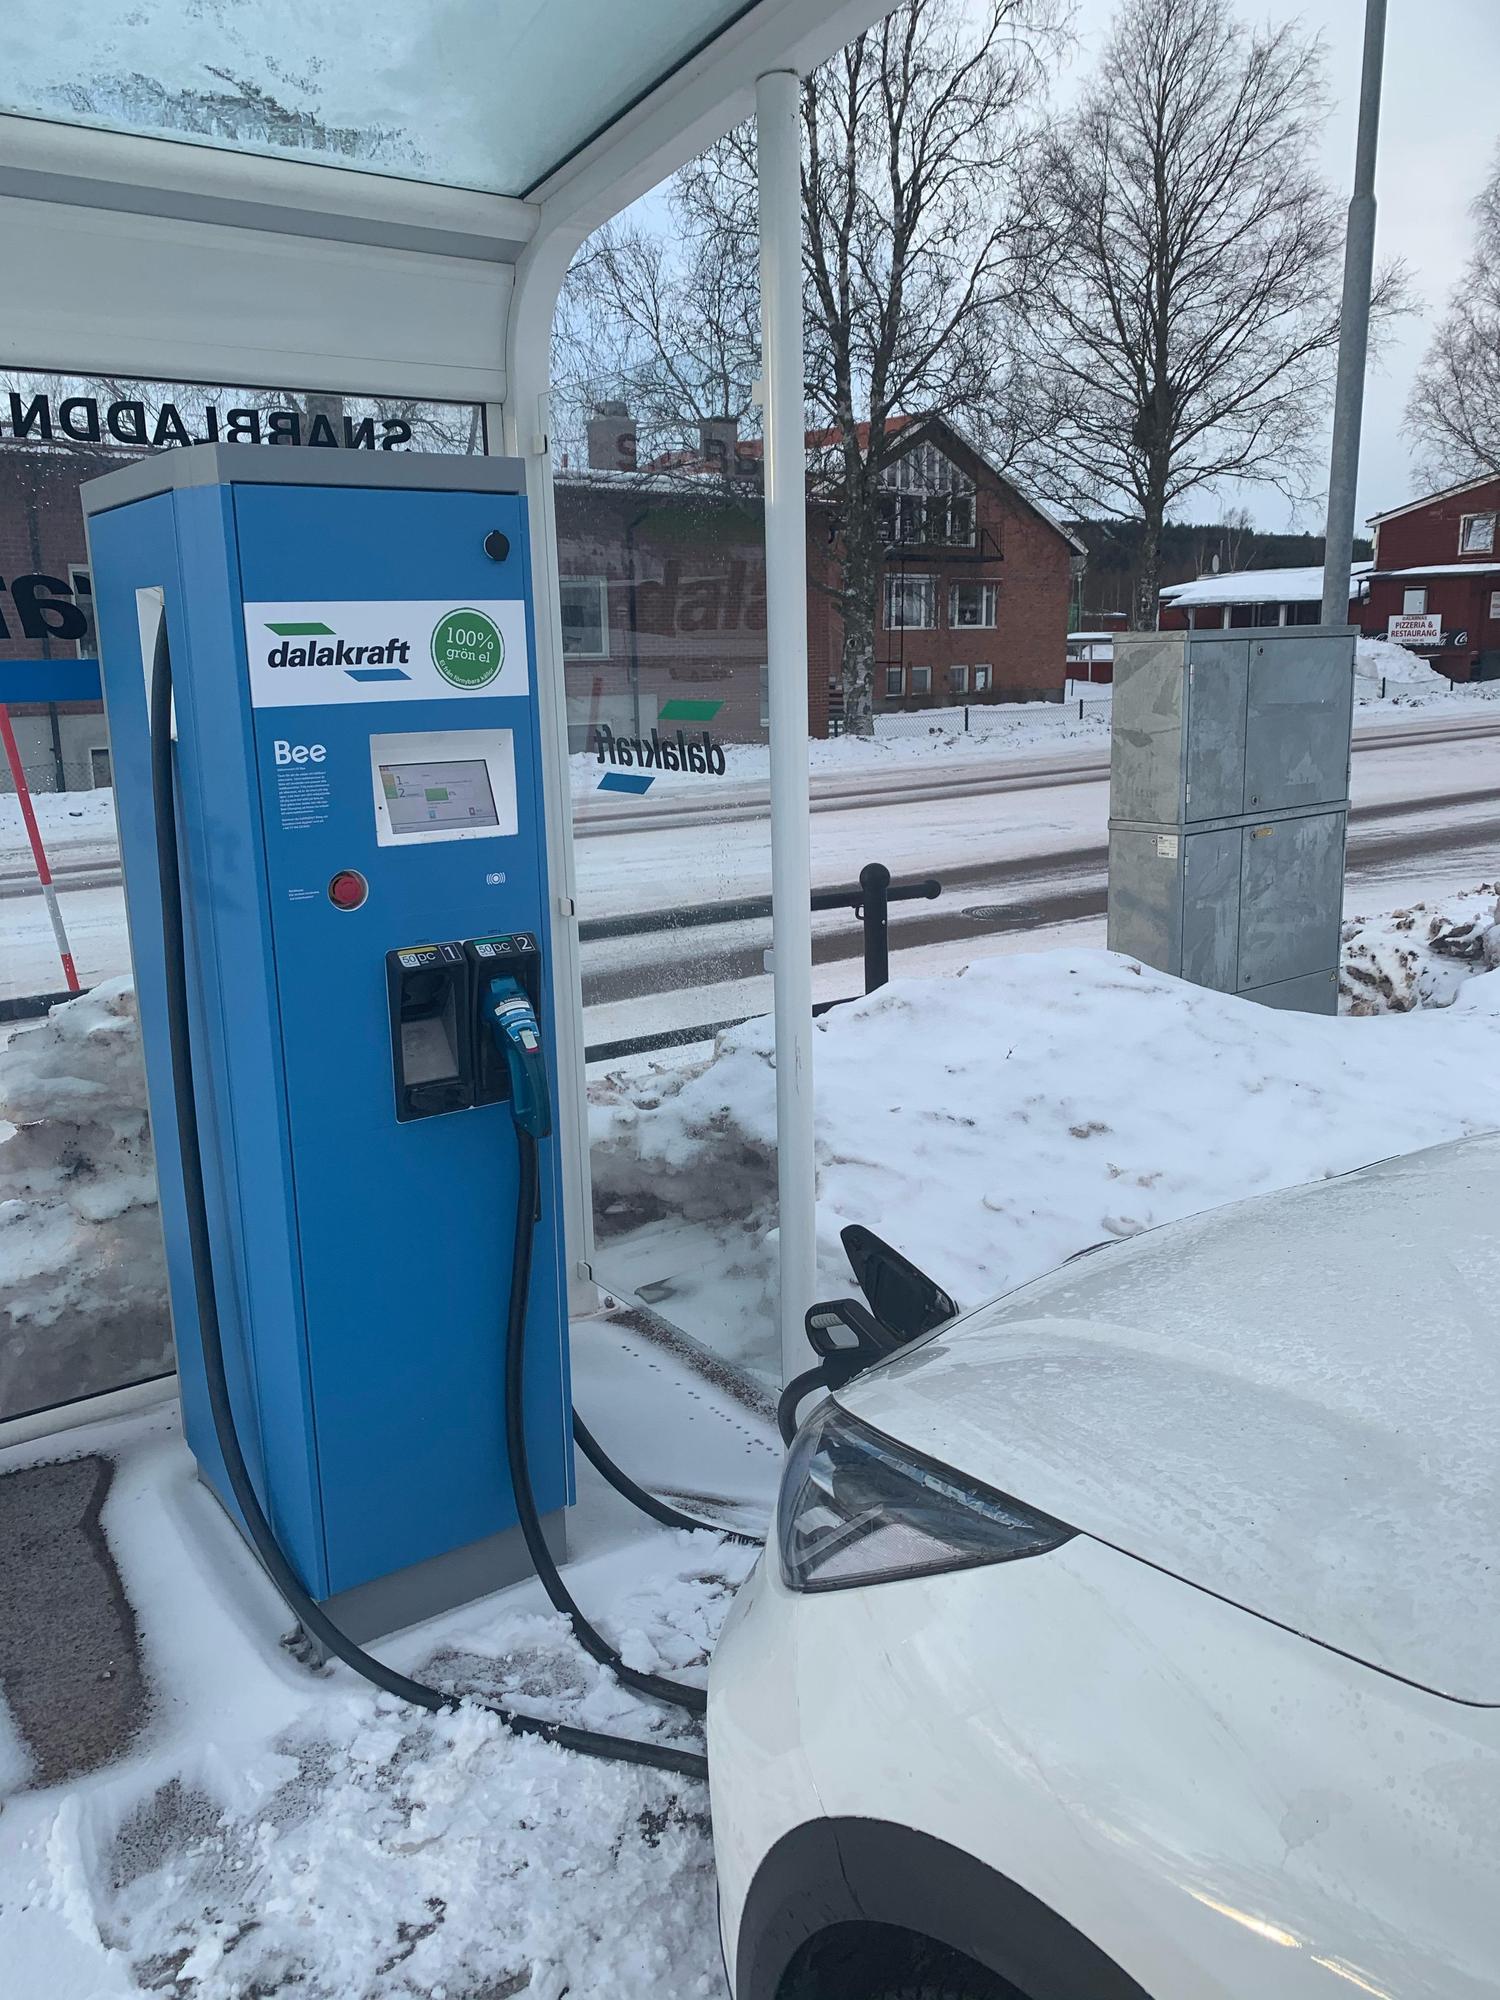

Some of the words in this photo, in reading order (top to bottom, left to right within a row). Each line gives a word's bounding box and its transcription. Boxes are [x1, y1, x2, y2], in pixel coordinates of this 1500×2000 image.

[1390, 629, 1437, 637] RESTAURANG
[1395, 621, 1426, 629] PIZZERIA
[446, 627, 494, 650] 100%
[267, 638, 411, 668] dalakraft
[446, 648, 476, 660] grön
[479, 652, 490, 663] el
[273, 740, 327, 765] Bee
[396, 775, 403, 786] 1
[398, 788, 406, 798] 2
[478, 945, 492, 954] 50
[493, 942, 511, 952] DC
[516, 936, 532, 950] 2
[401, 955, 417, 964] 50
[417, 952, 436, 962] DC
[444, 946, 456, 960] 1
